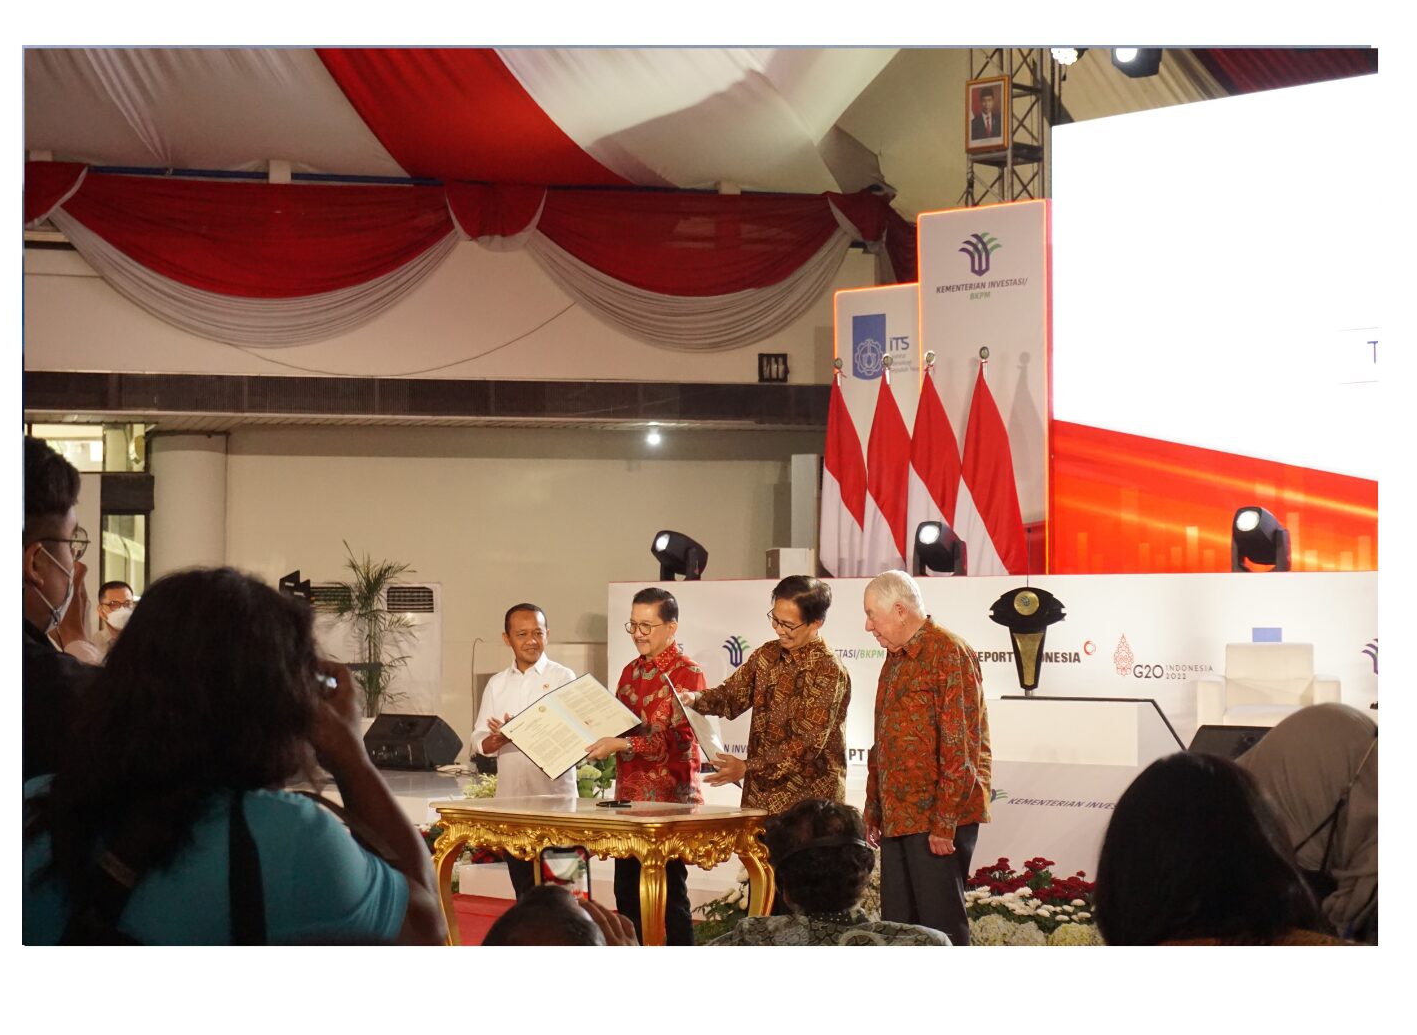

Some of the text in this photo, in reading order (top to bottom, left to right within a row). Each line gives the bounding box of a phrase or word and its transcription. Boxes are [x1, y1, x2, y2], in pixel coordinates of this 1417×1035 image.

[936, 281, 986, 294] KEMENTERIAN
[969, 291, 991, 301] BKPM
[1132, 664, 1214, 679] G20 INDONESIA
[1165, 672, 1187, 680] 2022
[848, 748, 865, 761] PT
[1007, 797, 1084, 808] KEMENTERIAN
